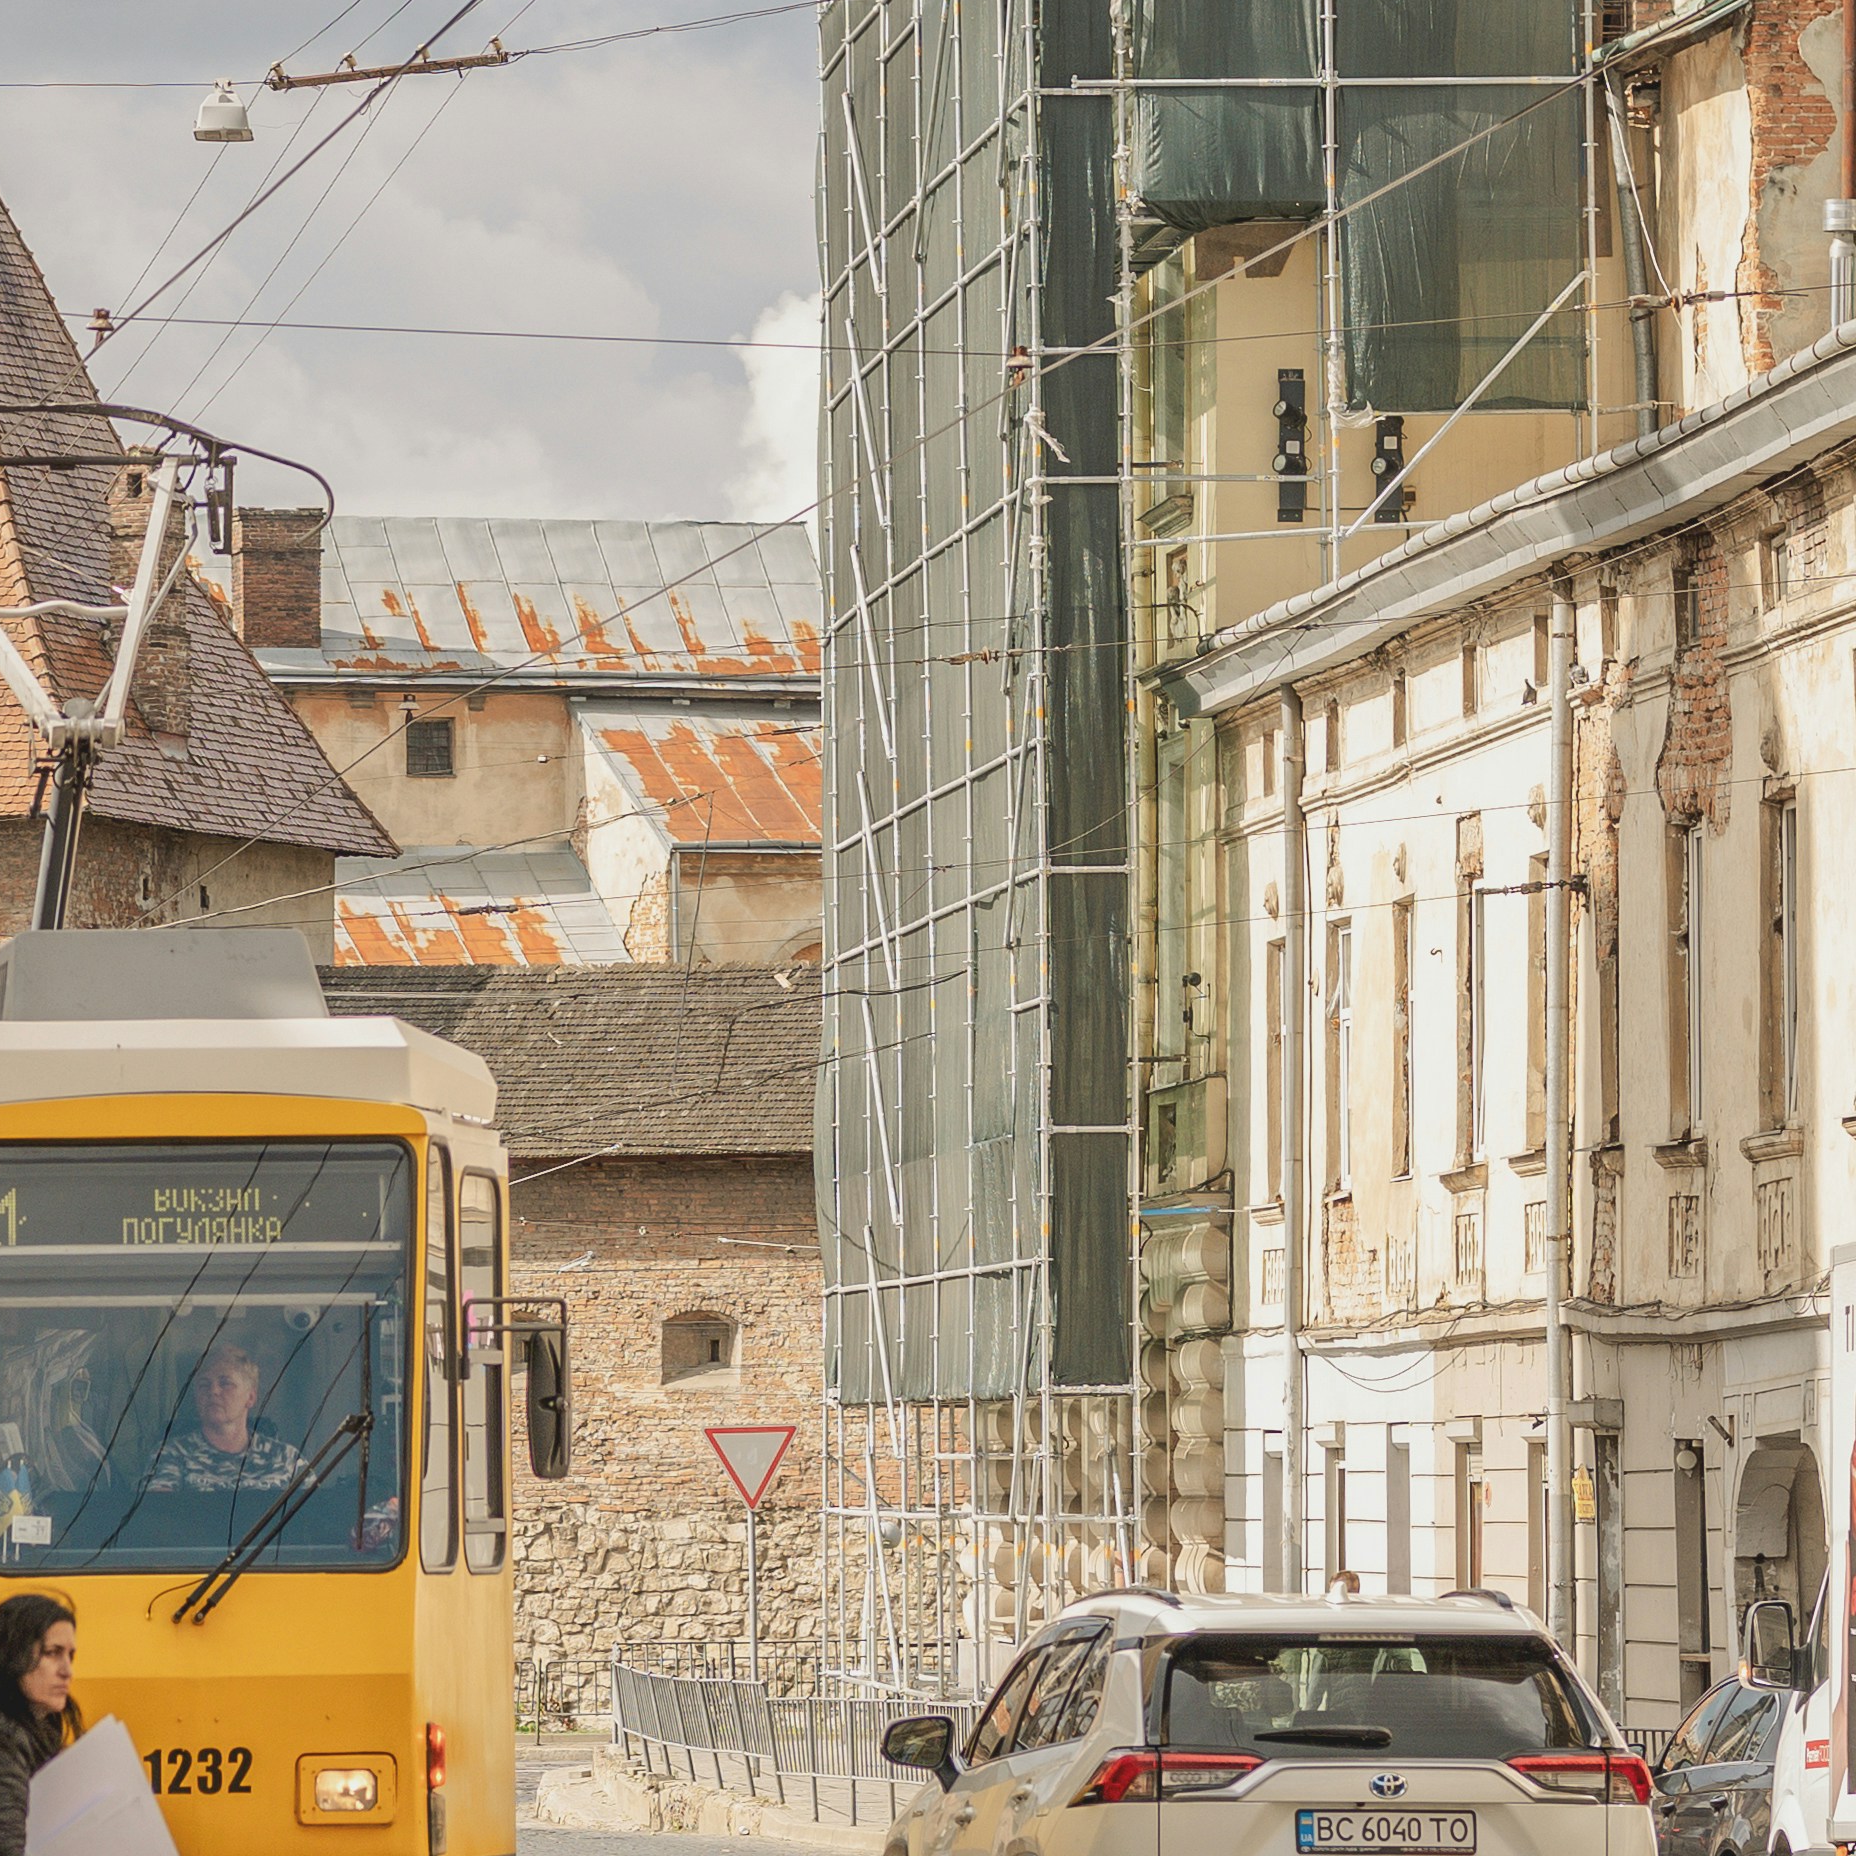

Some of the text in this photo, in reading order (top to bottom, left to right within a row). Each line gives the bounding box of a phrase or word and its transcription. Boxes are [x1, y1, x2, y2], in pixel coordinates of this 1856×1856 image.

[122, 1217, 282, 1245] ПОГУЛЯНКА
[143, 1746, 253, 1795] 1232
[1300, 1834, 1314, 1843] UA
[1317, 1817, 1468, 1843] BC 6040 TO
